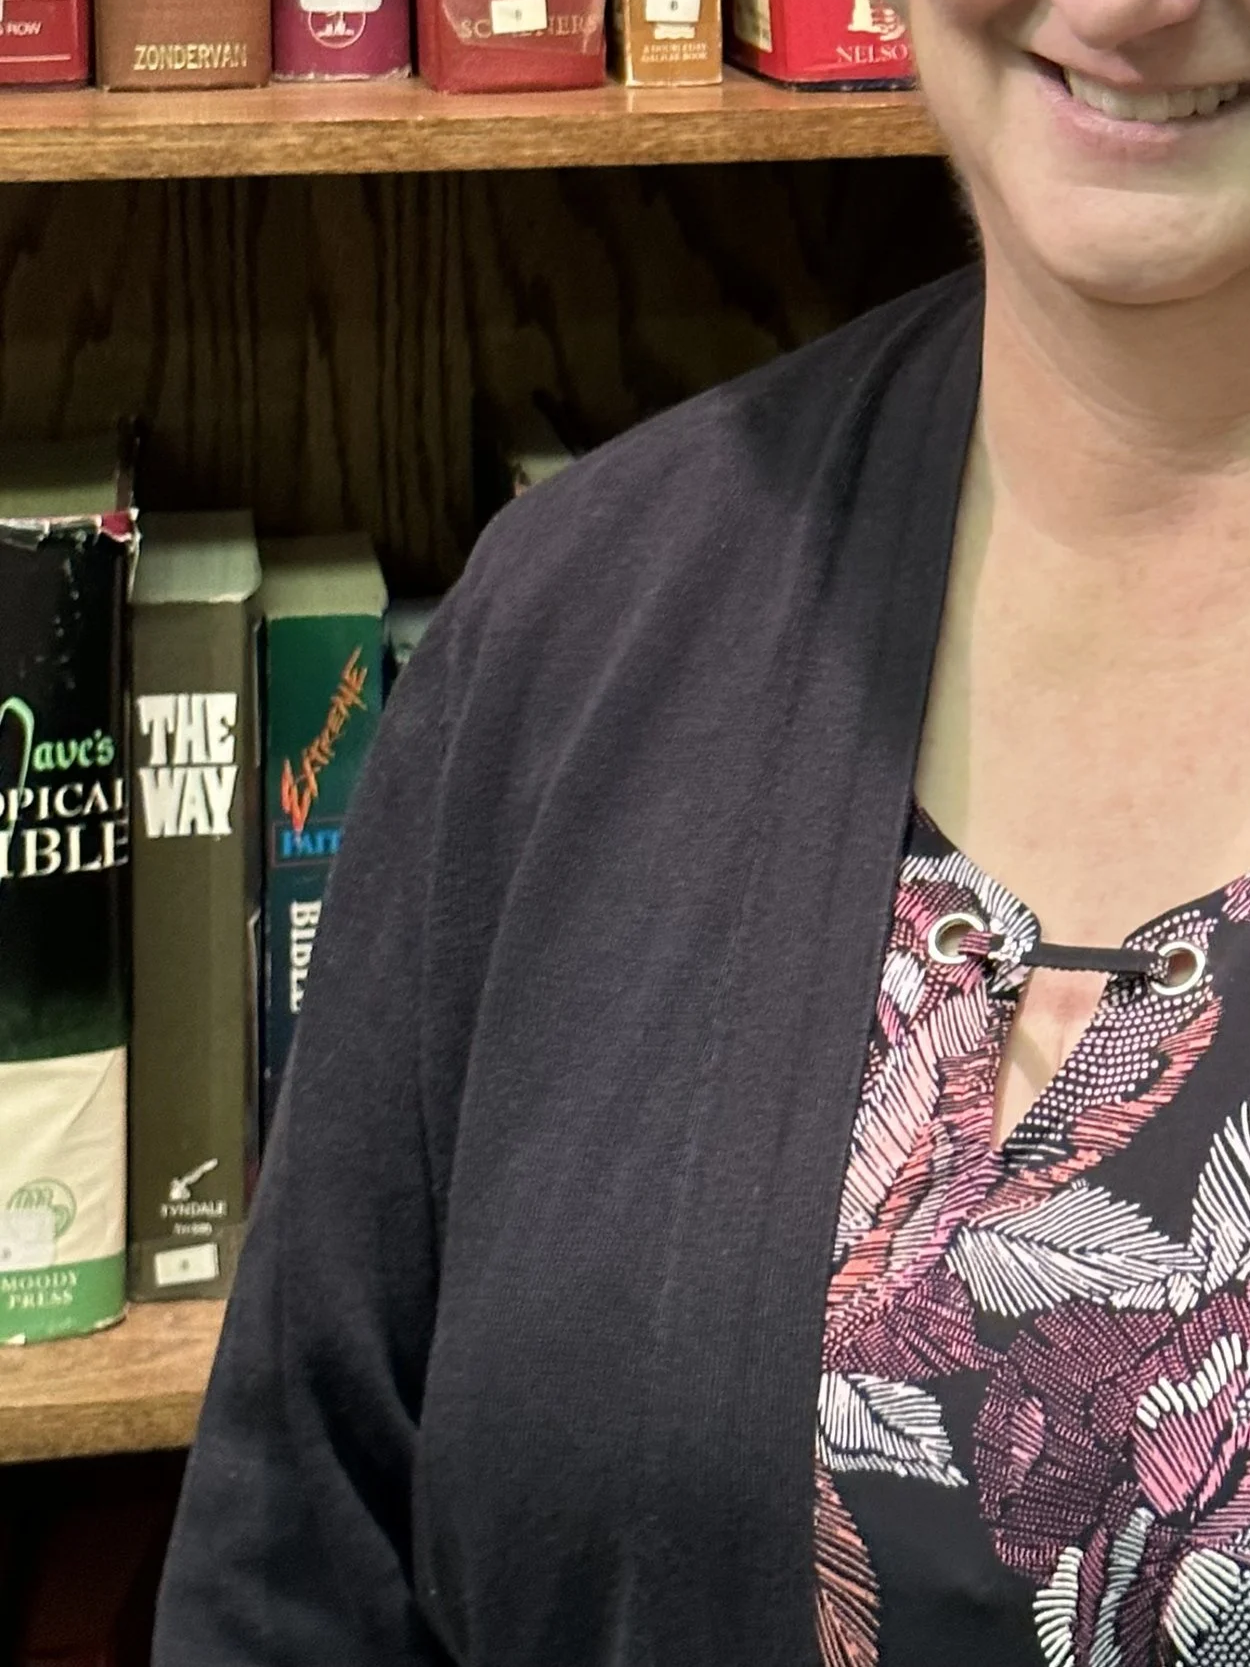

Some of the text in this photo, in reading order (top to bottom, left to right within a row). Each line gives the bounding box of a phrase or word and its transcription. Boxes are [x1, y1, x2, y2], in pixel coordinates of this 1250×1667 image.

[133, 42, 248, 71] ZONDERVAN
[137, 691, 239, 766] THE
[138, 765, 240, 838] WAY
[160, 1200, 229, 1218] TYNDALE
[8, 1289, 75, 1310] PRESS
